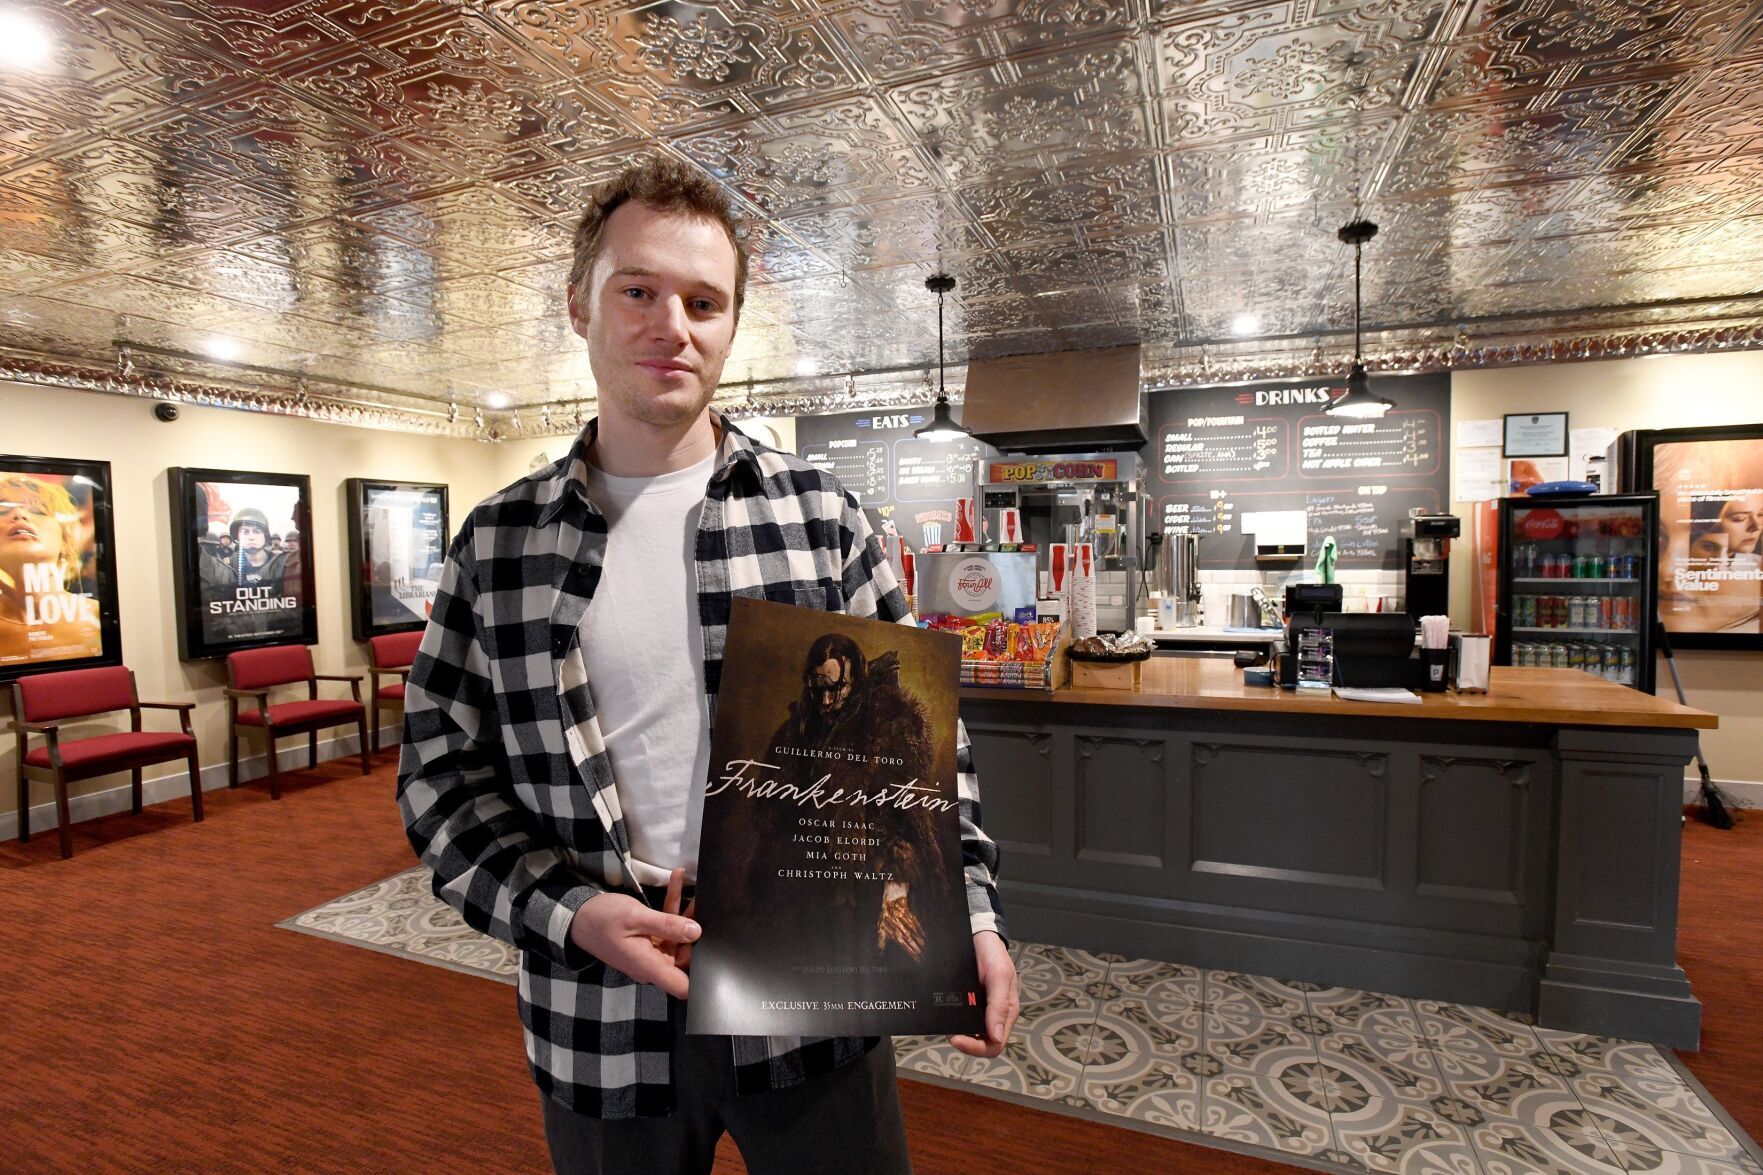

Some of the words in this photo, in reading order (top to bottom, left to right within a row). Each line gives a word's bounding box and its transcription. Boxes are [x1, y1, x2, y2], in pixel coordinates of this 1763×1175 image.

[1255, 387, 1330, 405] DRINKS
[872, 414, 910, 429] EATS
[1303, 425, 1340, 436] BOTTLED
[1165, 433, 1192, 442] SMALL
[1165, 443, 1204, 452] REGULAR
[1303, 448, 1322, 458] TEA
[1164, 454, 1184, 463] CAN
[1302, 459, 1323, 469] HOT
[1003, 464, 1038, 480] POP
[1053, 462, 1104, 479] CORN
[1165, 464, 1199, 474] BOTTLED
[1166, 504, 1189, 513] BEER
[1165, 514, 1190, 524] CIDER
[1164, 525, 1189, 534] WINE
[23, 562, 68, 593] MY
[1674, 567, 1763, 581] Sentiment
[1674, 580, 1720, 591] Value
[236, 586, 272, 600] OUT
[25, 592, 95, 626] LOVE
[210, 596, 297, 614] STANDING
[775, 746, 841, 760] GUILLERMO
[847, 753, 868, 762] DEL
[874, 756, 903, 766] TORO
[705, 759, 959, 812] Frankenstein
[798, 818, 836, 828] OSCAR
[842, 820, 875, 830] ISAAC
[792, 834, 830, 844] JACOB
[837, 836, 880, 846] ELORDI
[806, 851, 828, 860] MIA
[834, 852, 867, 861] GOTH
[778, 869, 847, 879] CHRISTOPH
[854, 871, 894, 880] WALTZ
[761, 1001, 819, 1010] EXCLUSIVE
[848, 1000, 917, 1011] ENGAGEMENT
